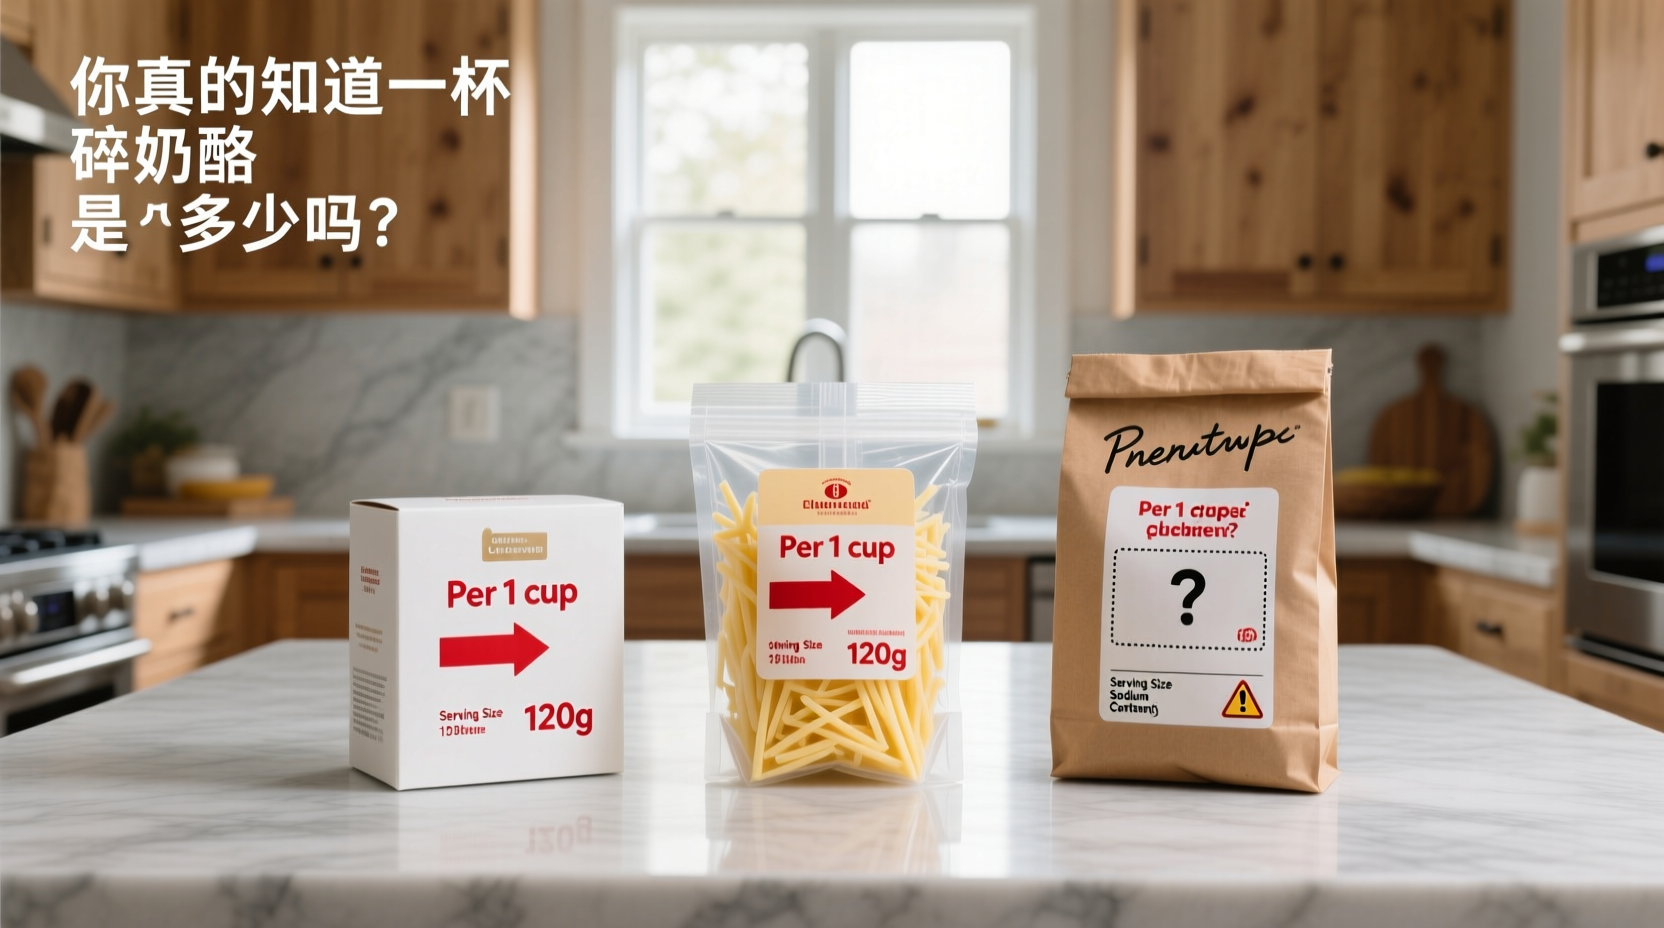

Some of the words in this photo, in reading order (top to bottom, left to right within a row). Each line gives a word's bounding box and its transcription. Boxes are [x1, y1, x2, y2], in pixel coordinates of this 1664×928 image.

[1138, 500, 1172, 517] Per
[1176, 501, 1184, 518] 1
[780, 534, 824, 559] Per
[828, 534, 840, 558] 1
[847, 540, 896, 565] cup
[447, 580, 497, 609] Per
[502, 578, 516, 605] 1
[523, 582, 579, 612] cup
[847, 641, 907, 672] 120g
[1109, 676, 1148, 691] Serving
[1150, 678, 1173, 690] Size
[439, 708, 479, 722] Serving
[524, 701, 593, 737] 120g
